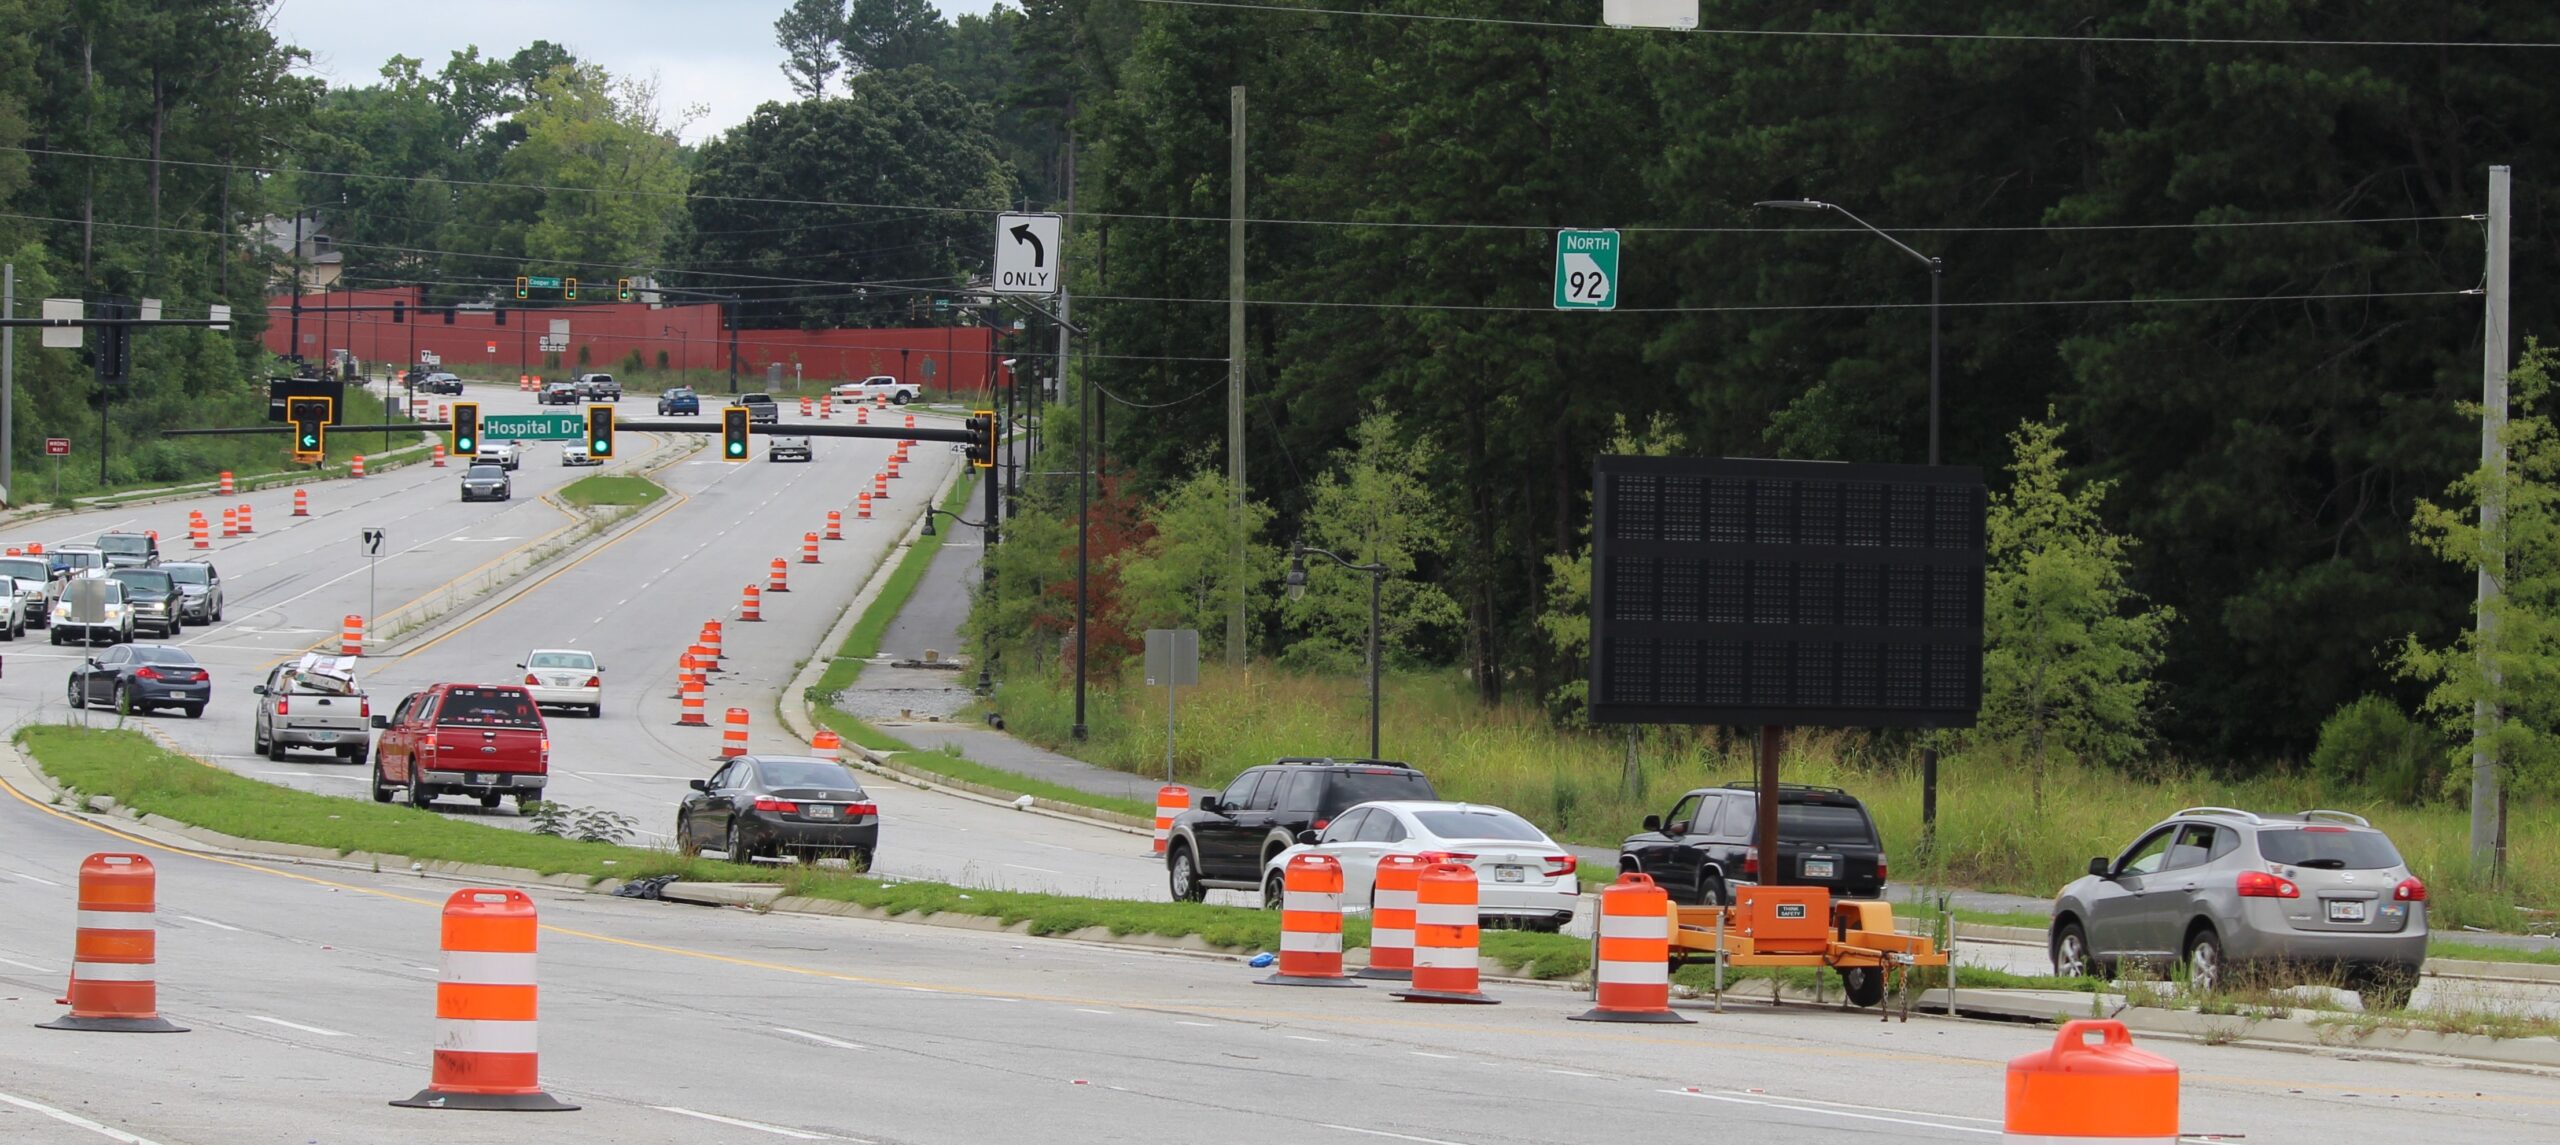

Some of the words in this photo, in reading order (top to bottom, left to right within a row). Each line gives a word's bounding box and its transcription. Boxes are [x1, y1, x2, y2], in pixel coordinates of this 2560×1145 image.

[1567, 236, 1610, 250] NORTH
[1003, 271, 1048, 287] ONLY
[1570, 271, 1603, 298] 92
[487, 420, 551, 437] Hospital
[561, 419, 580, 434] Dr
[951, 444, 967, 453] 45
